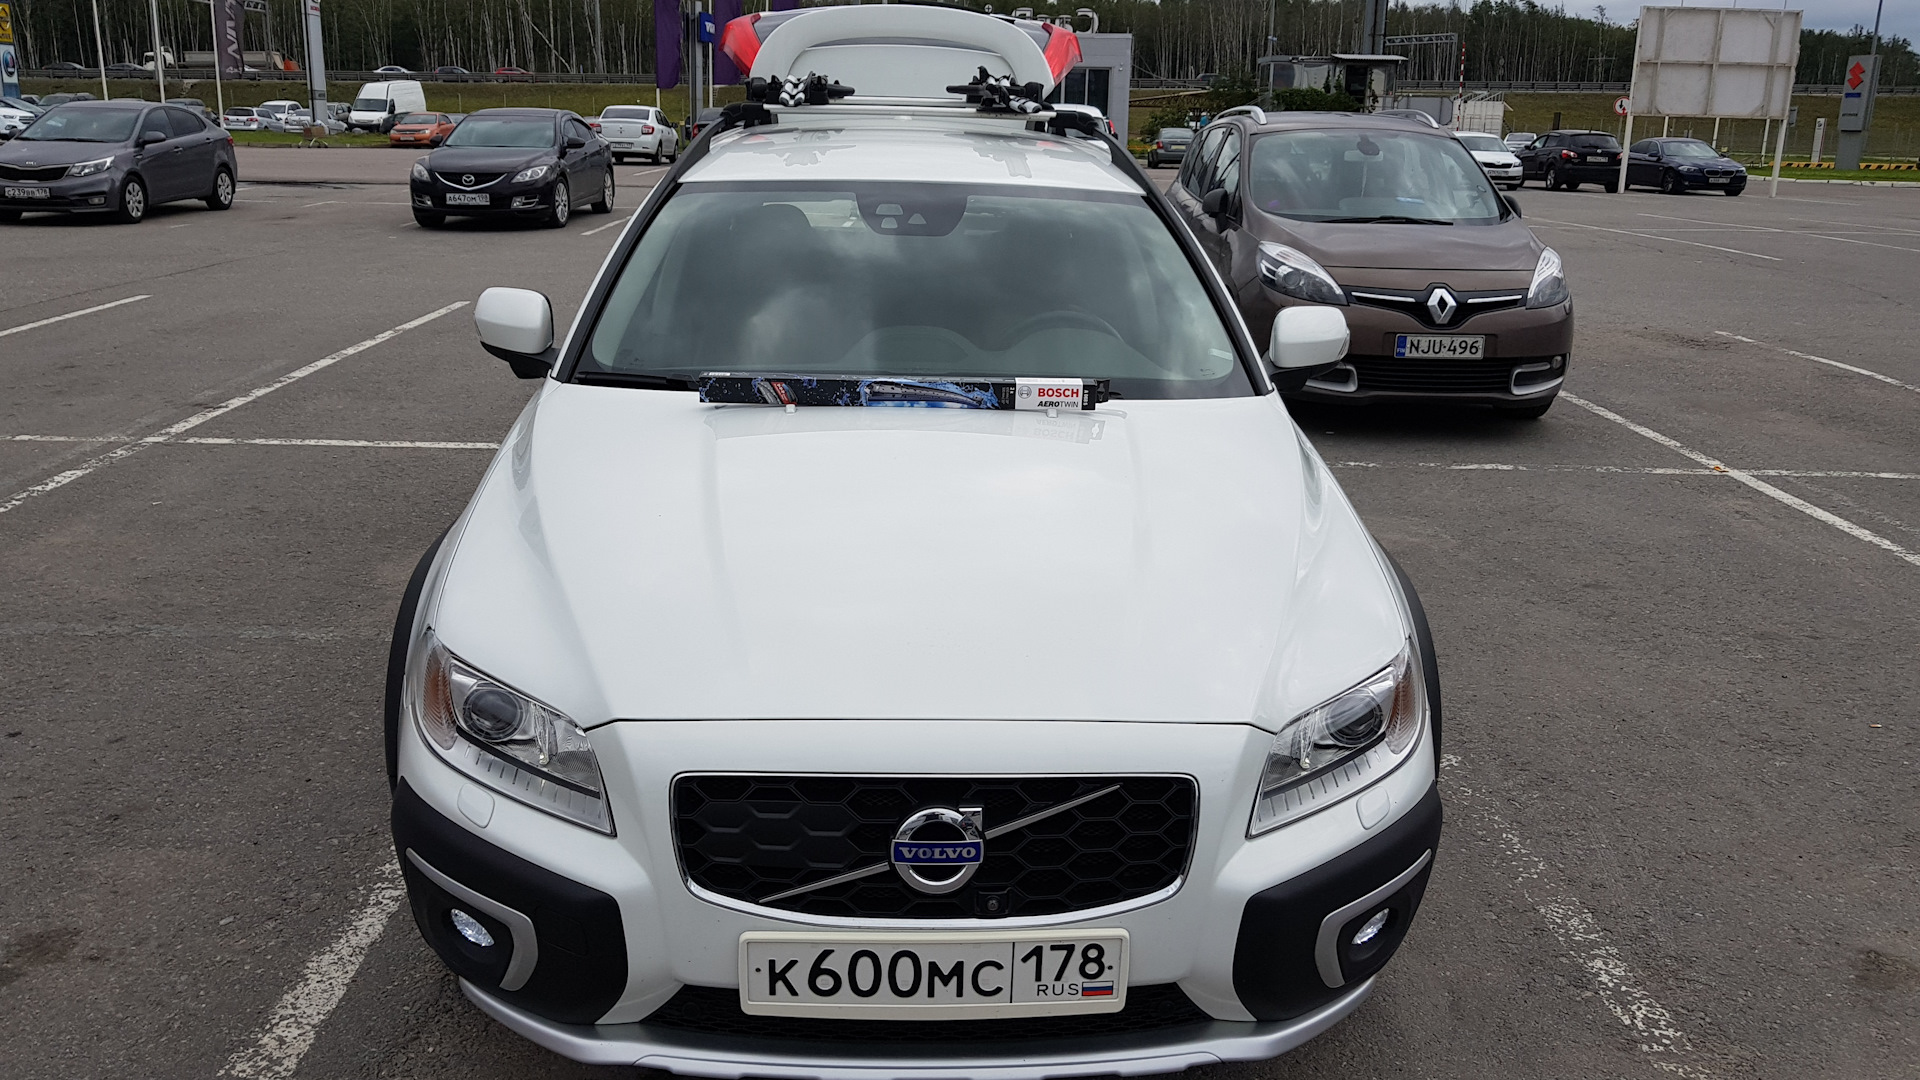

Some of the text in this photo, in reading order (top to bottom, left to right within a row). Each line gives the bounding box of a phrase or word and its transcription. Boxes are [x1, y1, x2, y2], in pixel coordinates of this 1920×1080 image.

[1037, 388, 1079, 398] BOSCH
[898, 845, 977, 860] VOLVO
[1020, 943, 1106, 982] 178
[1036, 983, 1080, 996] RUS
